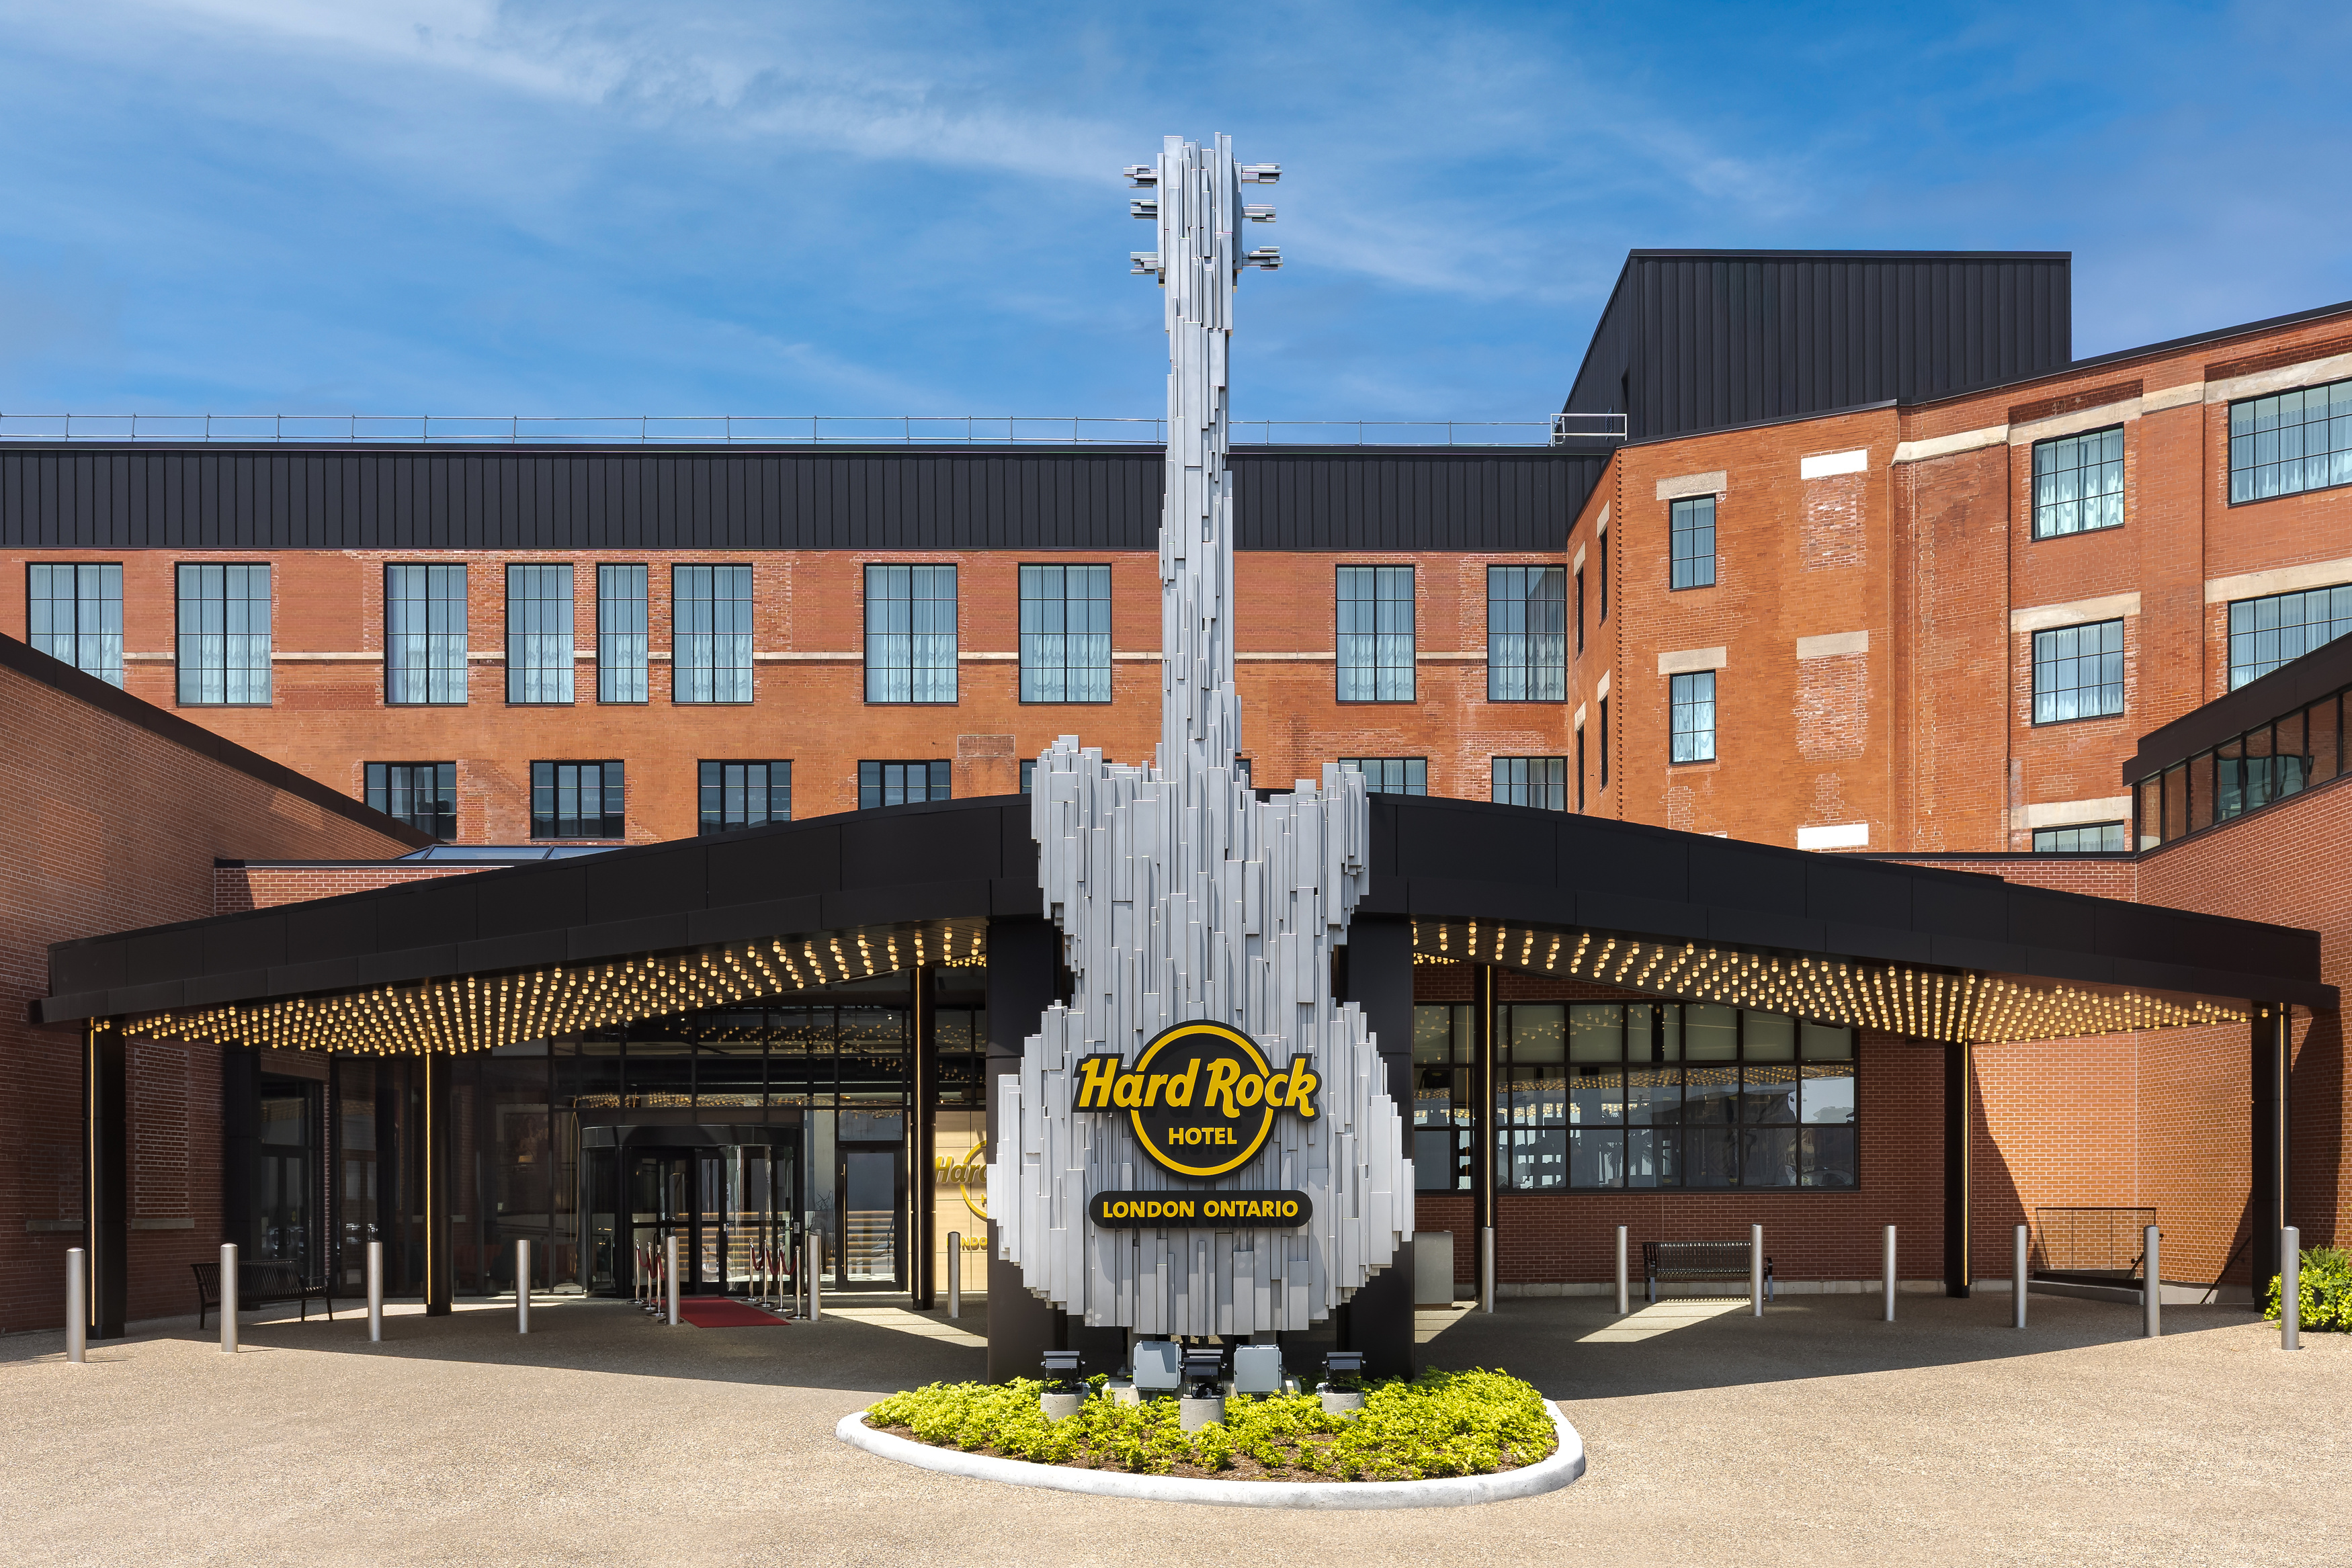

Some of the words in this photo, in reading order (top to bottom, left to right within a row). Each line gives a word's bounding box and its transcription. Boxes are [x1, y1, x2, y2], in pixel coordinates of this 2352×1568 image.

[1079, 1058, 1202, 1107] Hard
[1204, 1057, 1317, 1119] Rock
[1169, 1127, 1238, 1145] HOTEL
[1103, 1201, 1195, 1218] LONDON
[1203, 1200, 1298, 1217] ONTARIO
